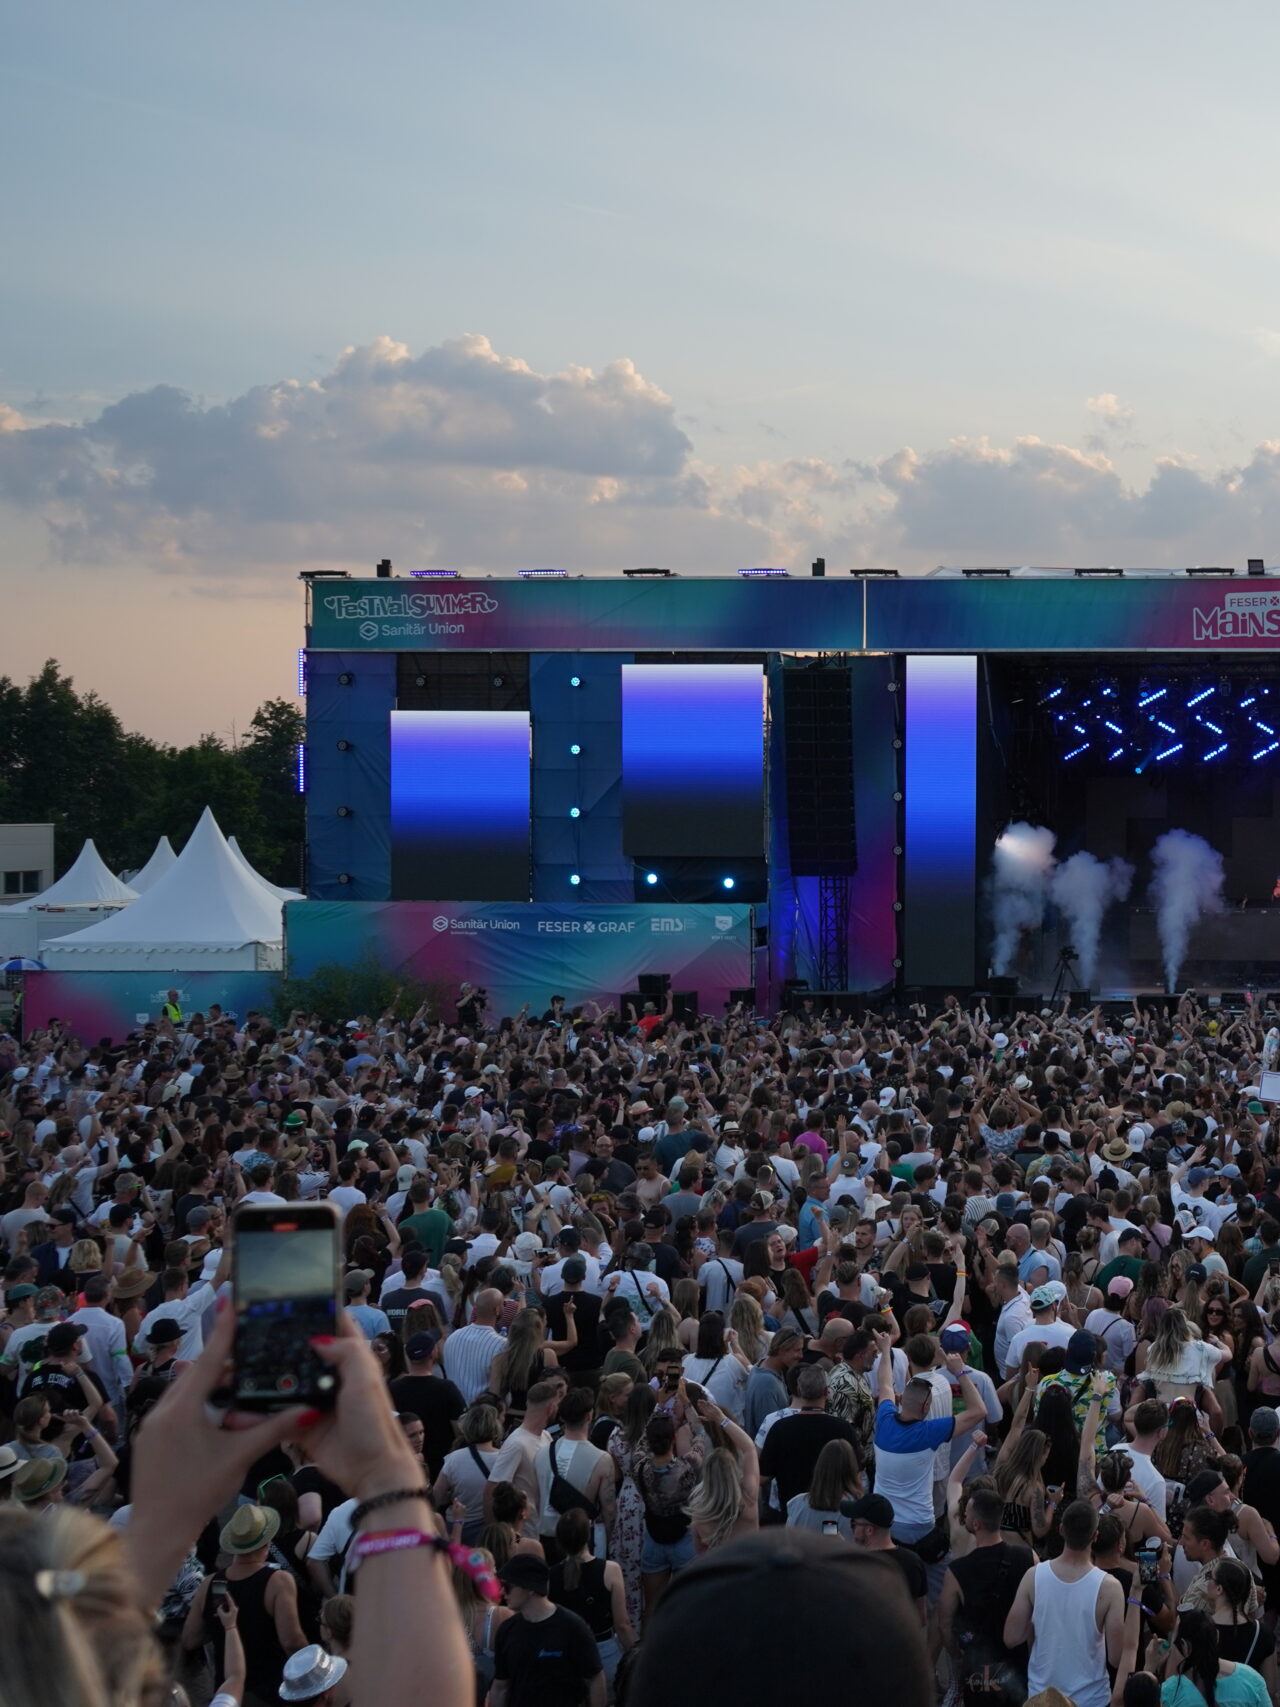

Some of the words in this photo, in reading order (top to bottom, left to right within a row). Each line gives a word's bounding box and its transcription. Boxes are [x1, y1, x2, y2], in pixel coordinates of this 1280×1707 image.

[1229, 597, 1267, 607] FESER
[381, 622, 426, 637] Sanitär
[428, 622, 465, 635] Union
[450, 918, 488, 929] Sanitär
[489, 919, 520, 930] Union
[537, 920, 581, 933] FESER
[598, 921, 636, 933] GRAF
